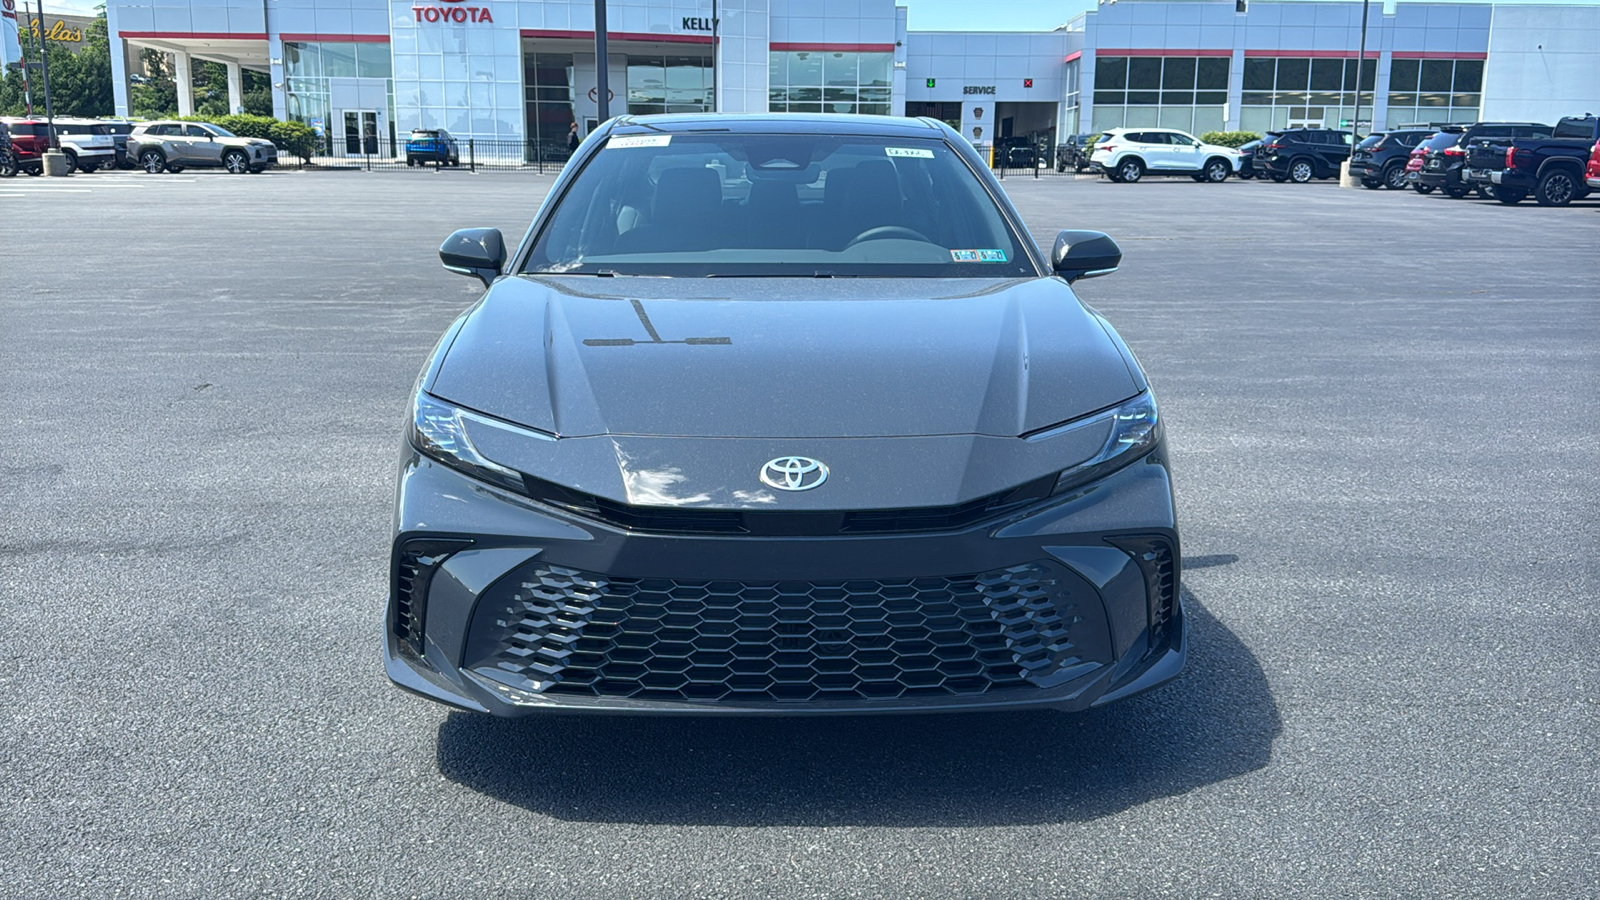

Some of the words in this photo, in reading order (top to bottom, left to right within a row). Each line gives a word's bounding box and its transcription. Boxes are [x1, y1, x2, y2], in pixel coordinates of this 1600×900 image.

[412, 7, 493, 23] TOYOTA
[682, 17, 720, 31] KELLY
[963, 86, 996, 95] SERVICE
